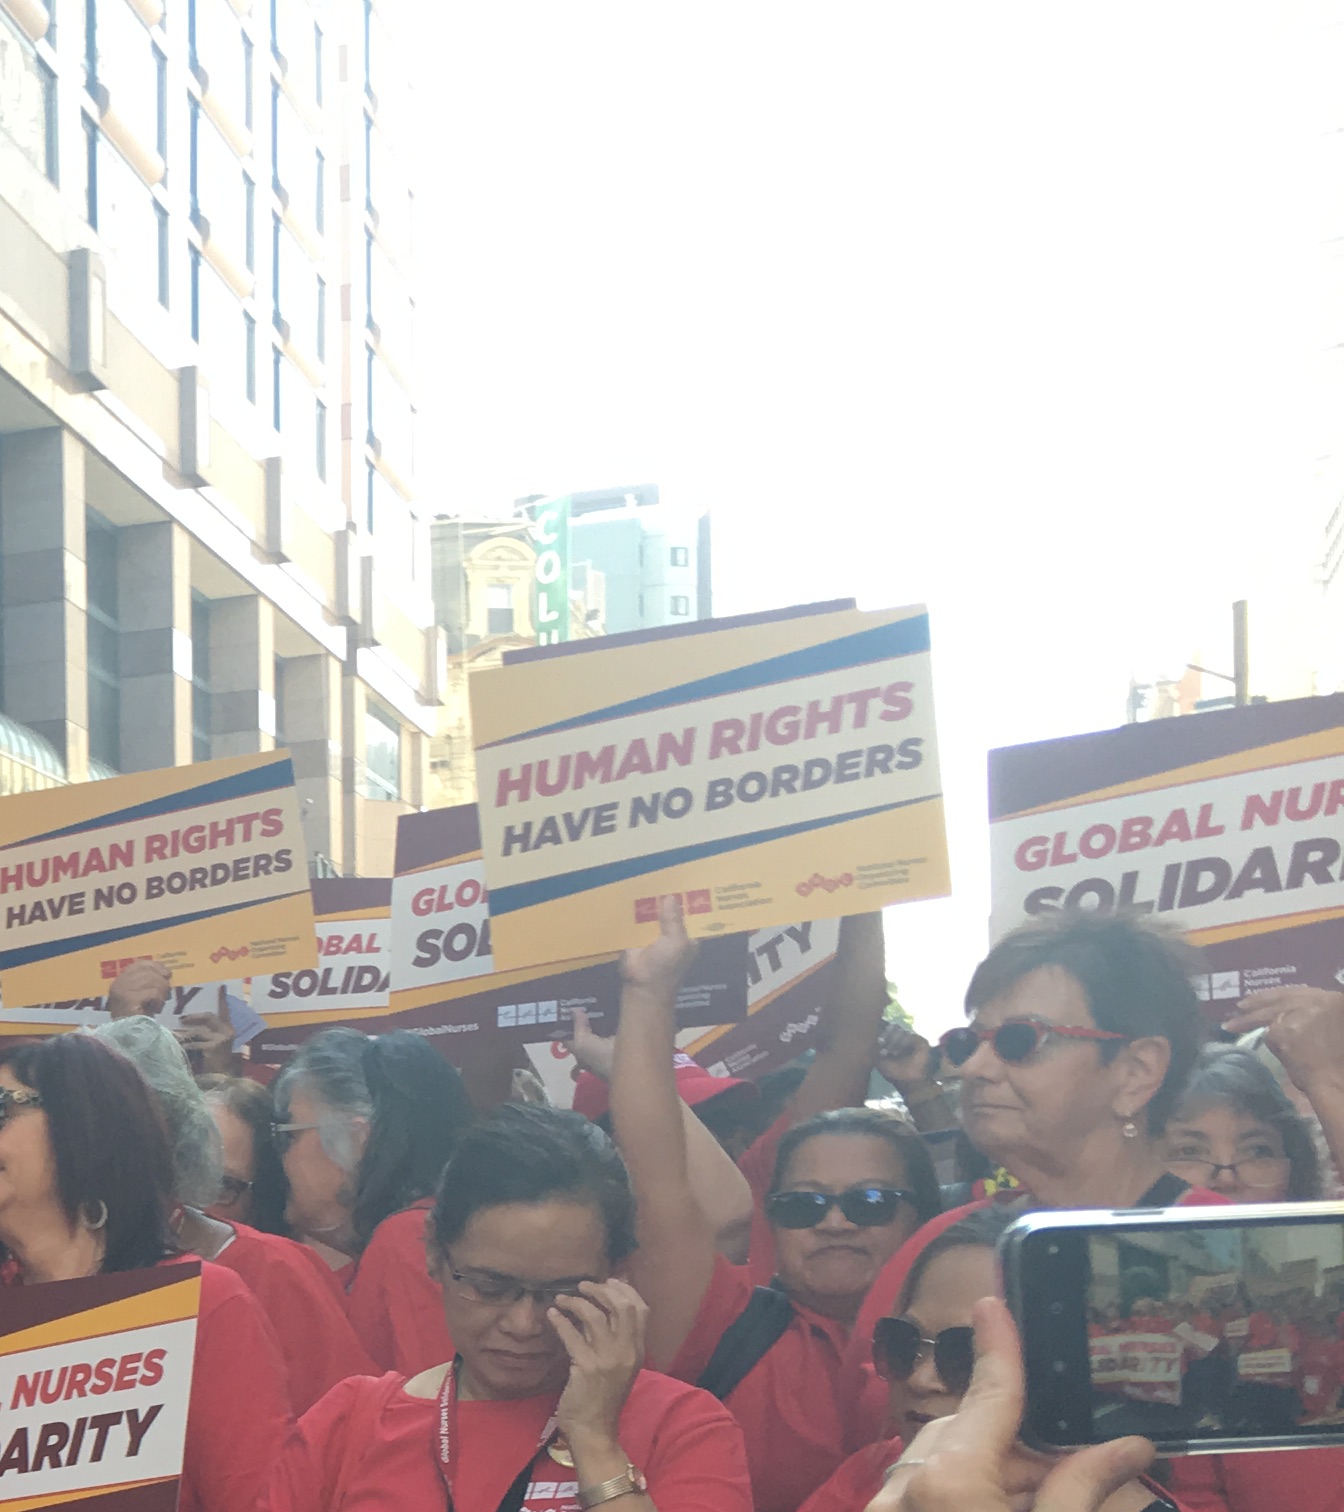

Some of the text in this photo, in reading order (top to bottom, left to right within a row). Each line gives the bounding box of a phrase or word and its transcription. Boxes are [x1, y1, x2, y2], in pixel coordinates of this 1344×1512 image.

[494, 681, 916, 807] HUMAN RIGHTS
[500, 736, 924, 857] HAVE NO BORDERS
[0, 808, 284, 894] HUMAN RIGHTS
[1015, 802, 1225, 872] GLOBAL
[1023, 837, 1344, 917] SOLIDAR
[7, 849, 293, 929] HAVE NO BORDERS
[10, 1348, 168, 1411] NURSES
